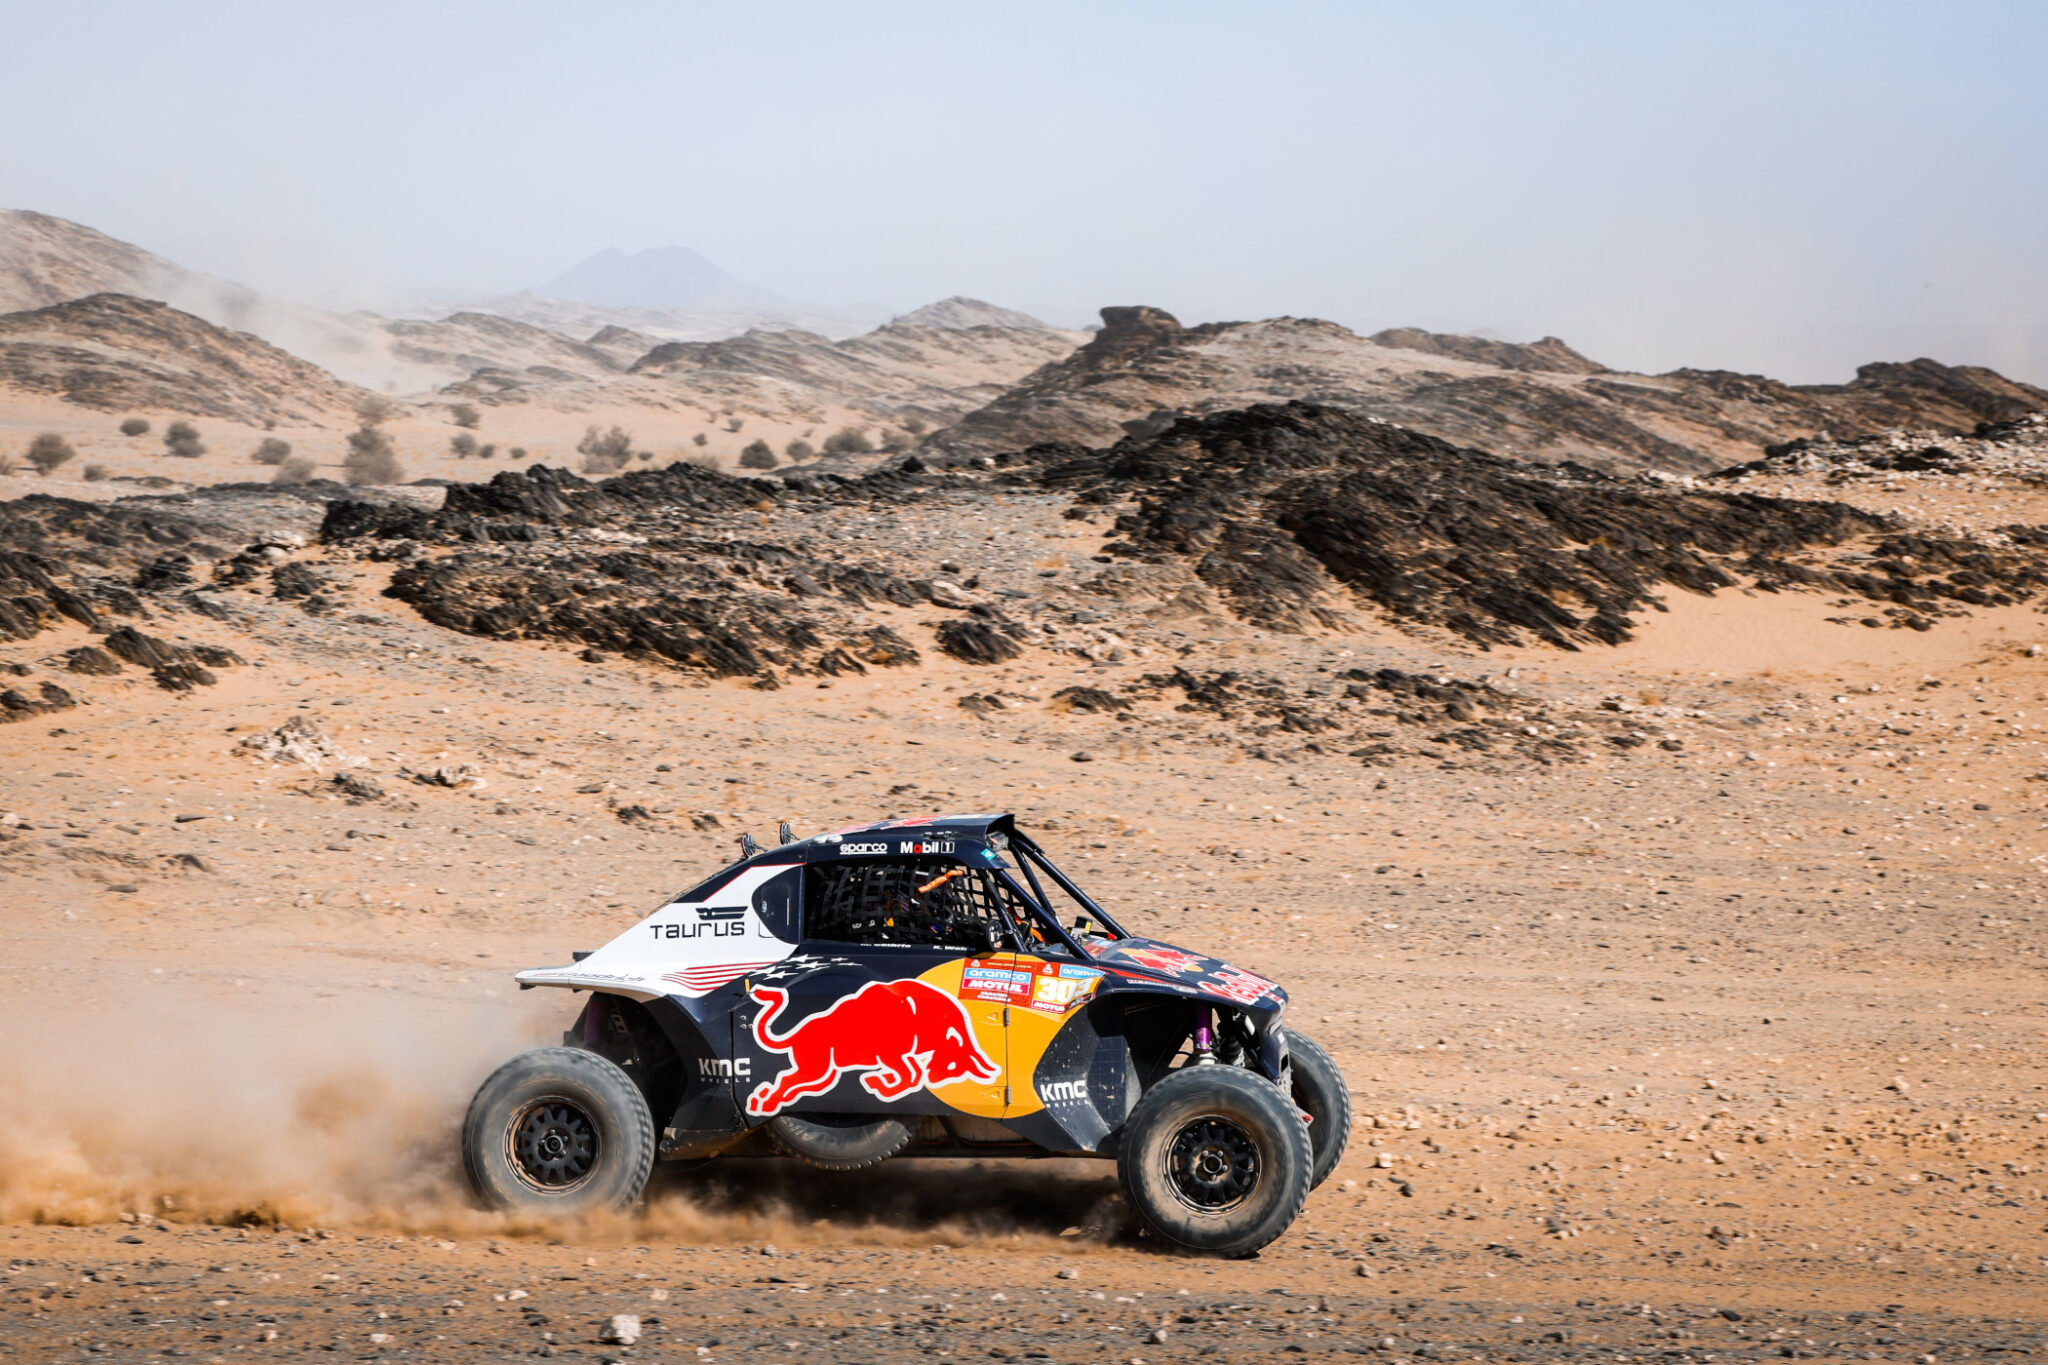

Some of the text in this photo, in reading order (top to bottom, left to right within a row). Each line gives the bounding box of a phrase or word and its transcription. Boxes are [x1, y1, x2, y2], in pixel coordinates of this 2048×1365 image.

[840, 843, 888, 853] sparco
[900, 841, 938, 854] Mobil
[969, 969, 1026, 981] aramco
[968, 980, 1023, 993] MOTUL
[1033, 1001, 1066, 1012] MOTUL
